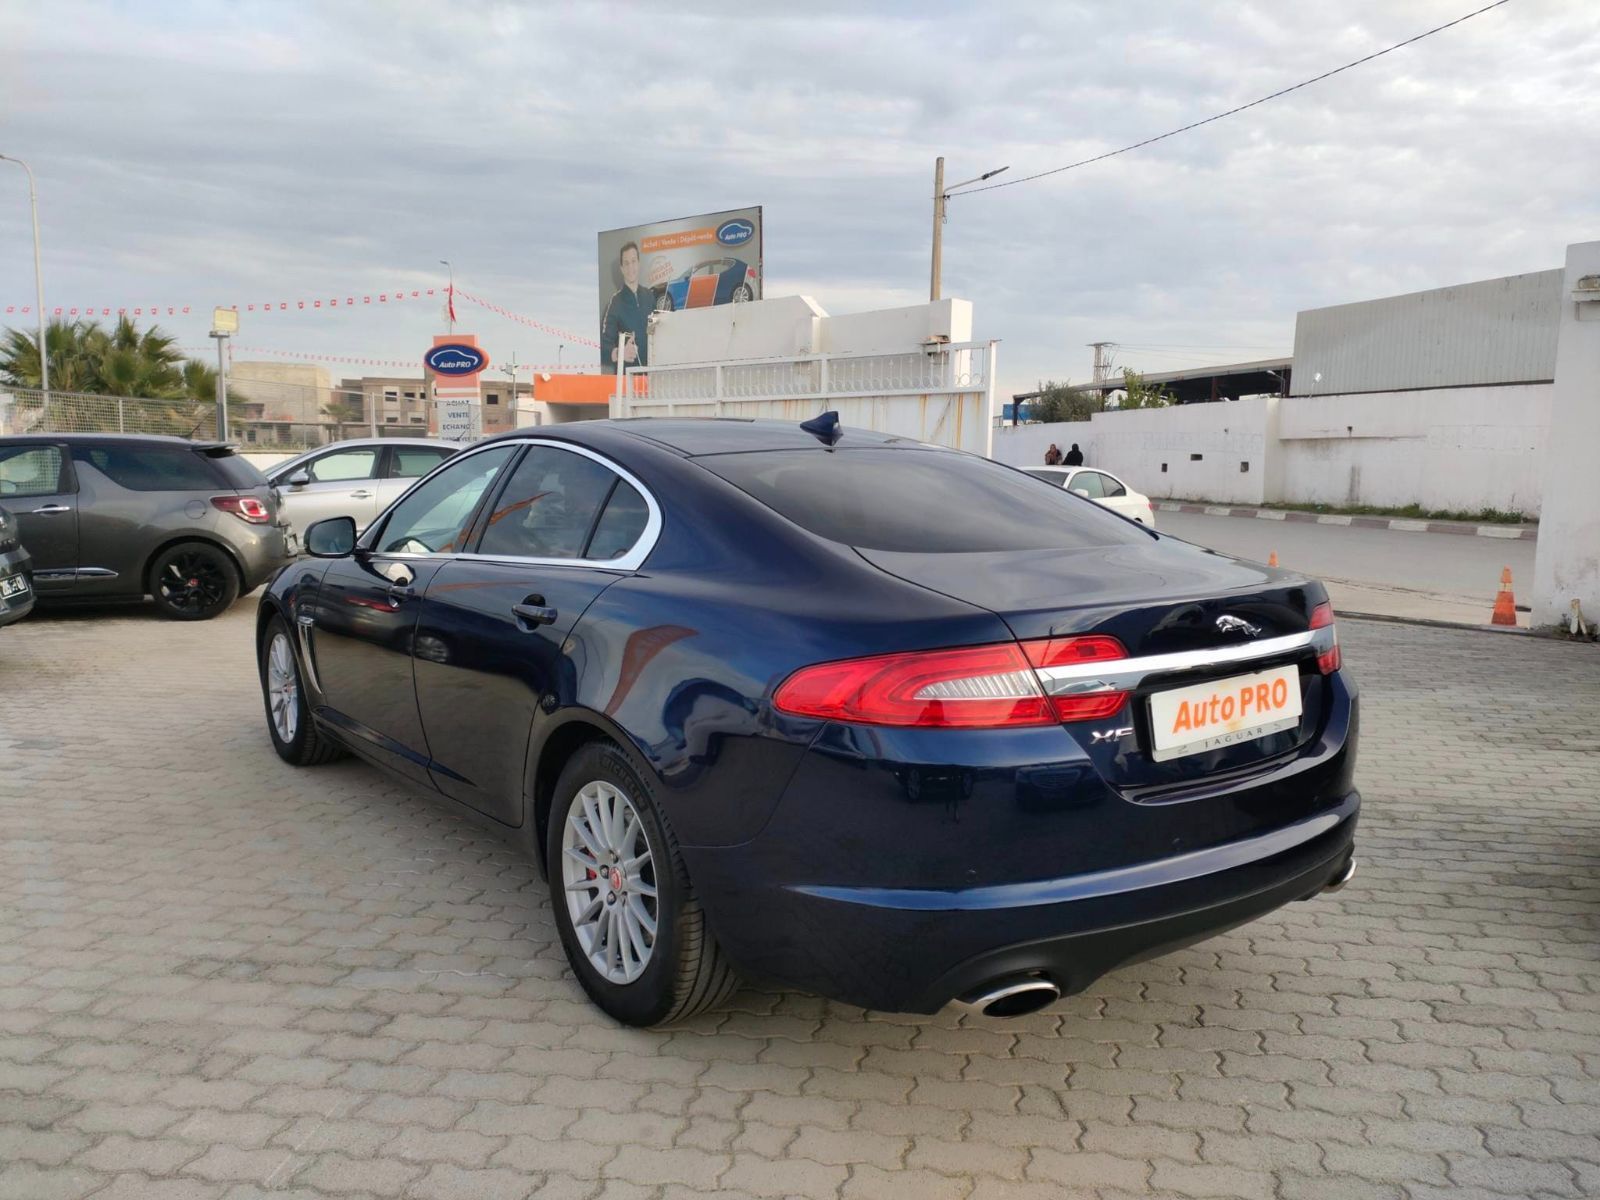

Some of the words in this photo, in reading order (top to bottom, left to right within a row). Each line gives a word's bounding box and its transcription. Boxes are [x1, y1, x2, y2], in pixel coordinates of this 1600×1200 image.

[1172, 694, 1235, 734] Auto
[1240, 677, 1288, 717] PRO
[1090, 727, 1134, 745] XF
[1204, 728, 1264, 750] JAGUAR
